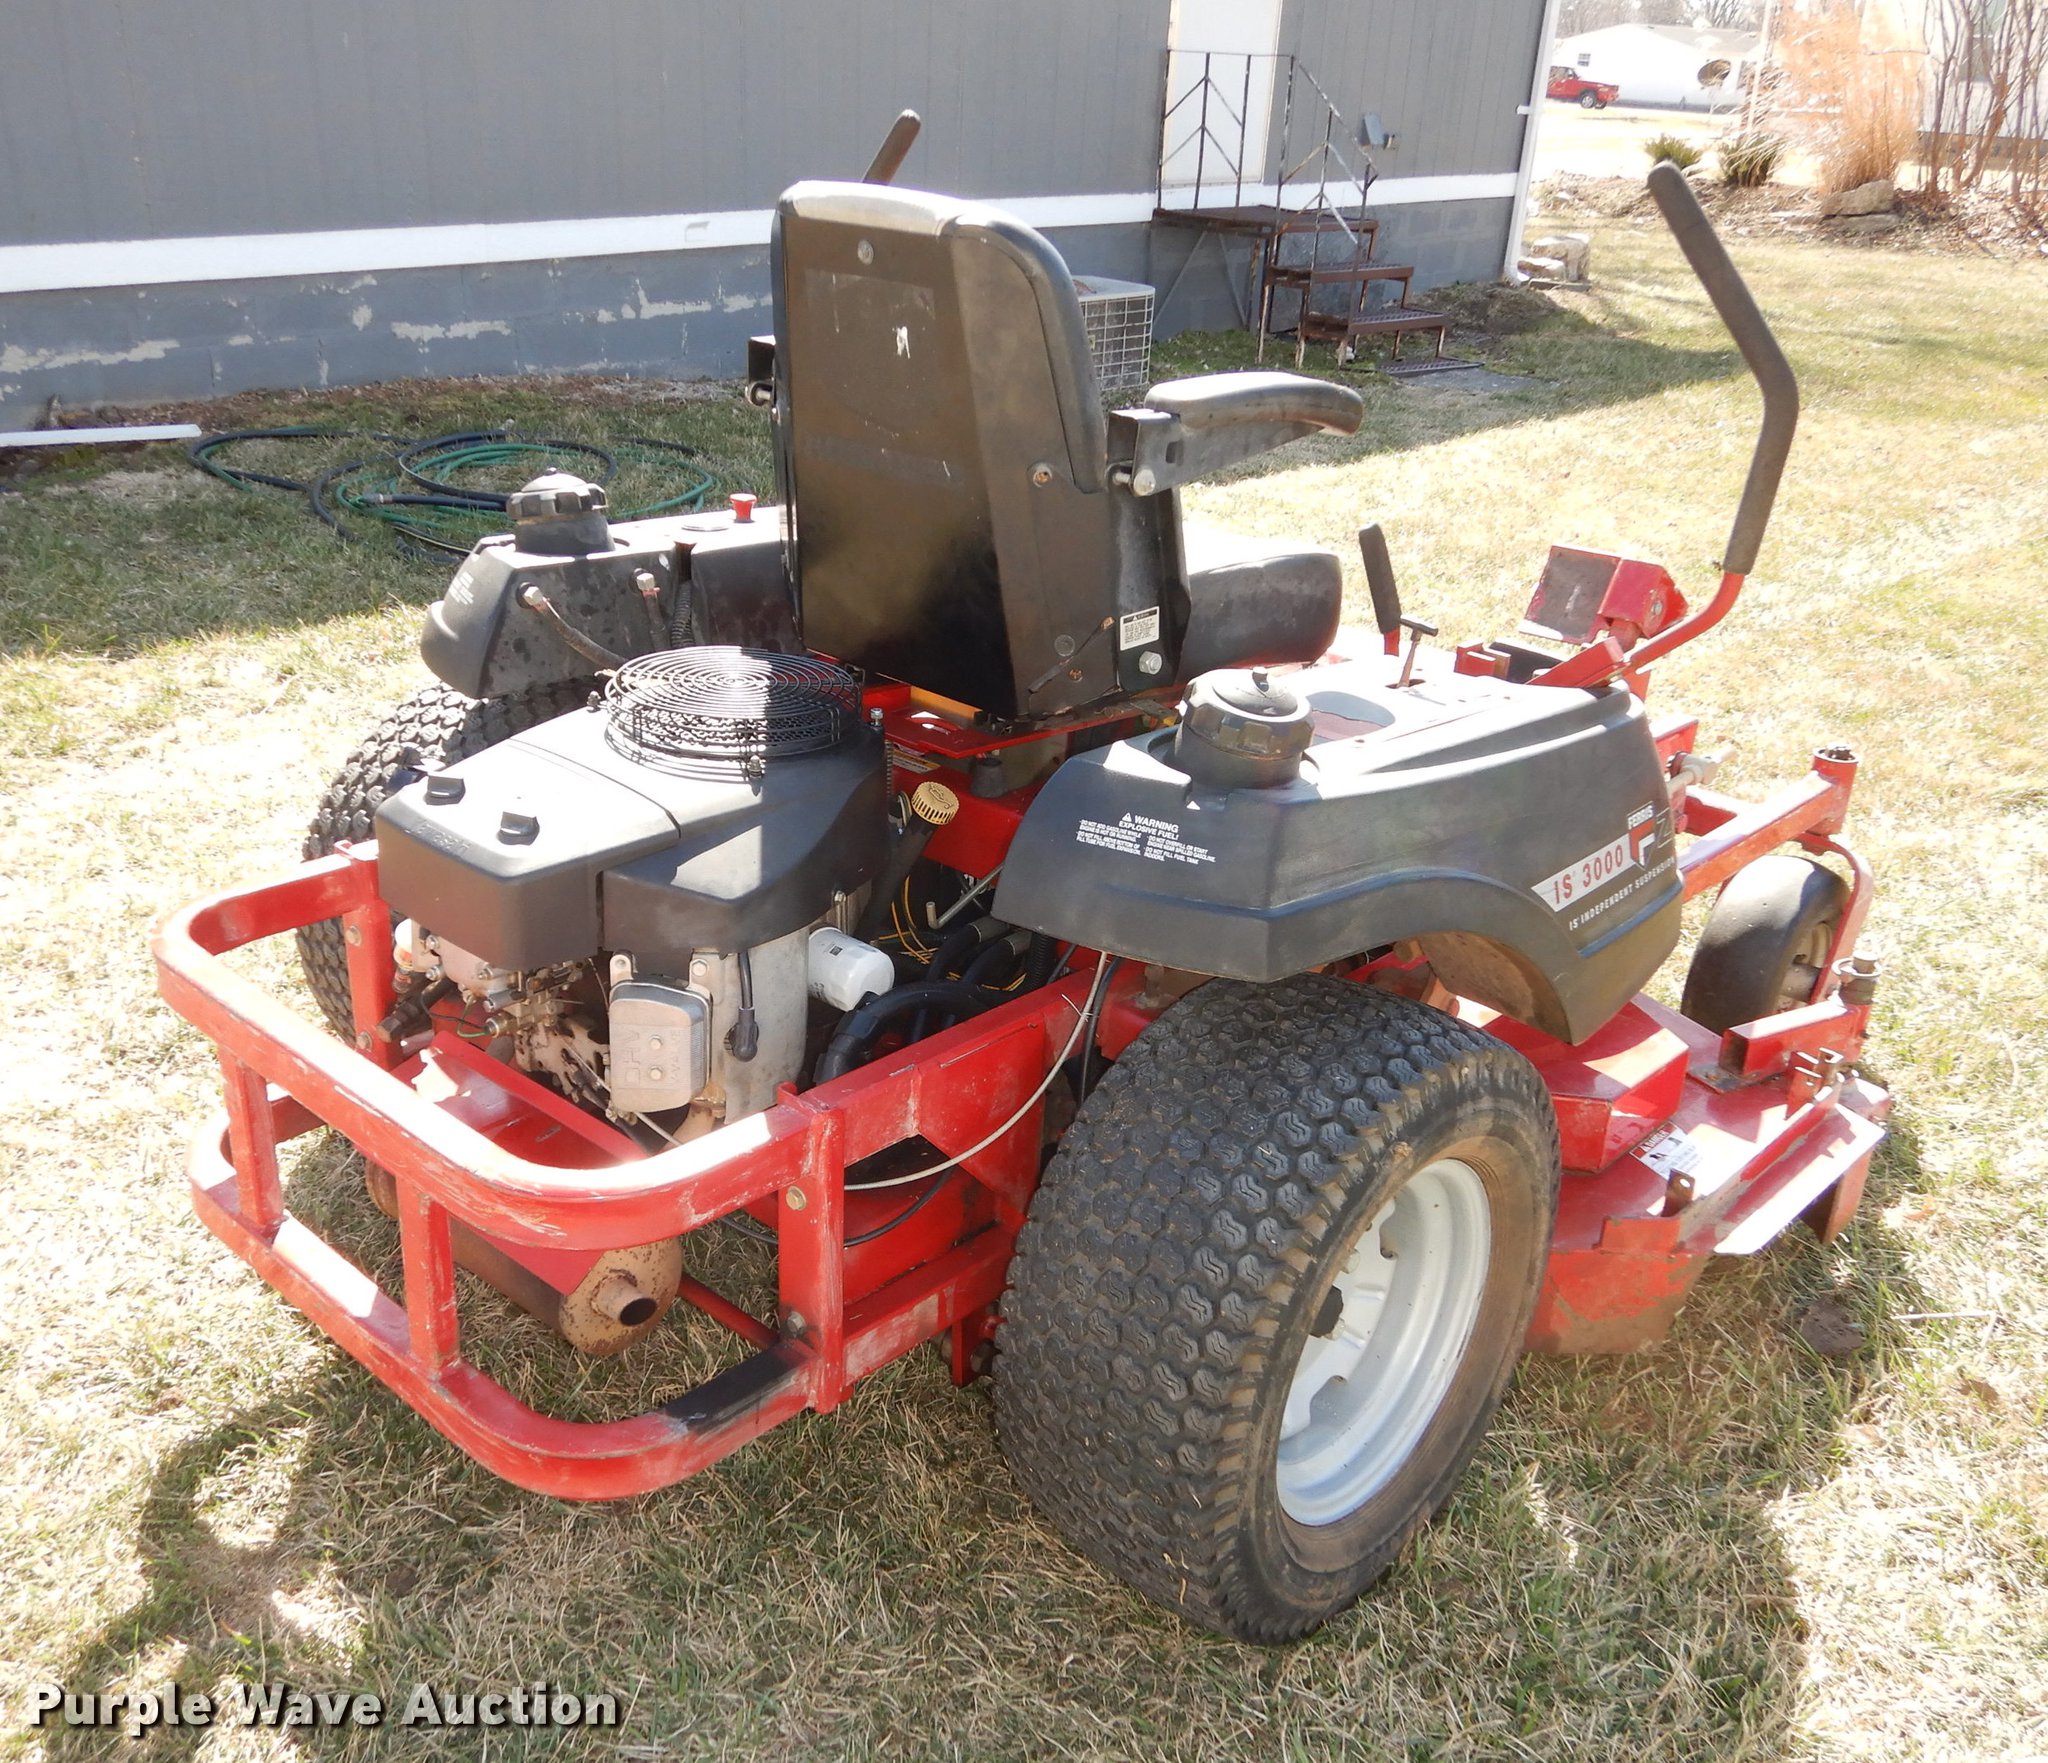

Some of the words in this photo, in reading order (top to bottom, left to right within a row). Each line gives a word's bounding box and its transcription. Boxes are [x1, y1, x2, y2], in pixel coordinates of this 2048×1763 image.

[1118, 820, 1158, 836] EXPLOSIVE
[1157, 829, 1179, 841] FUEL!
[1134, 814, 1179, 834] WARNING
[1627, 804, 1654, 831] FERRIS
[1582, 843, 1624, 888] 3000
[1580, 884, 1634, 924] INDEPENDENT
[1634, 856, 1676, 890] SUSPENSION
